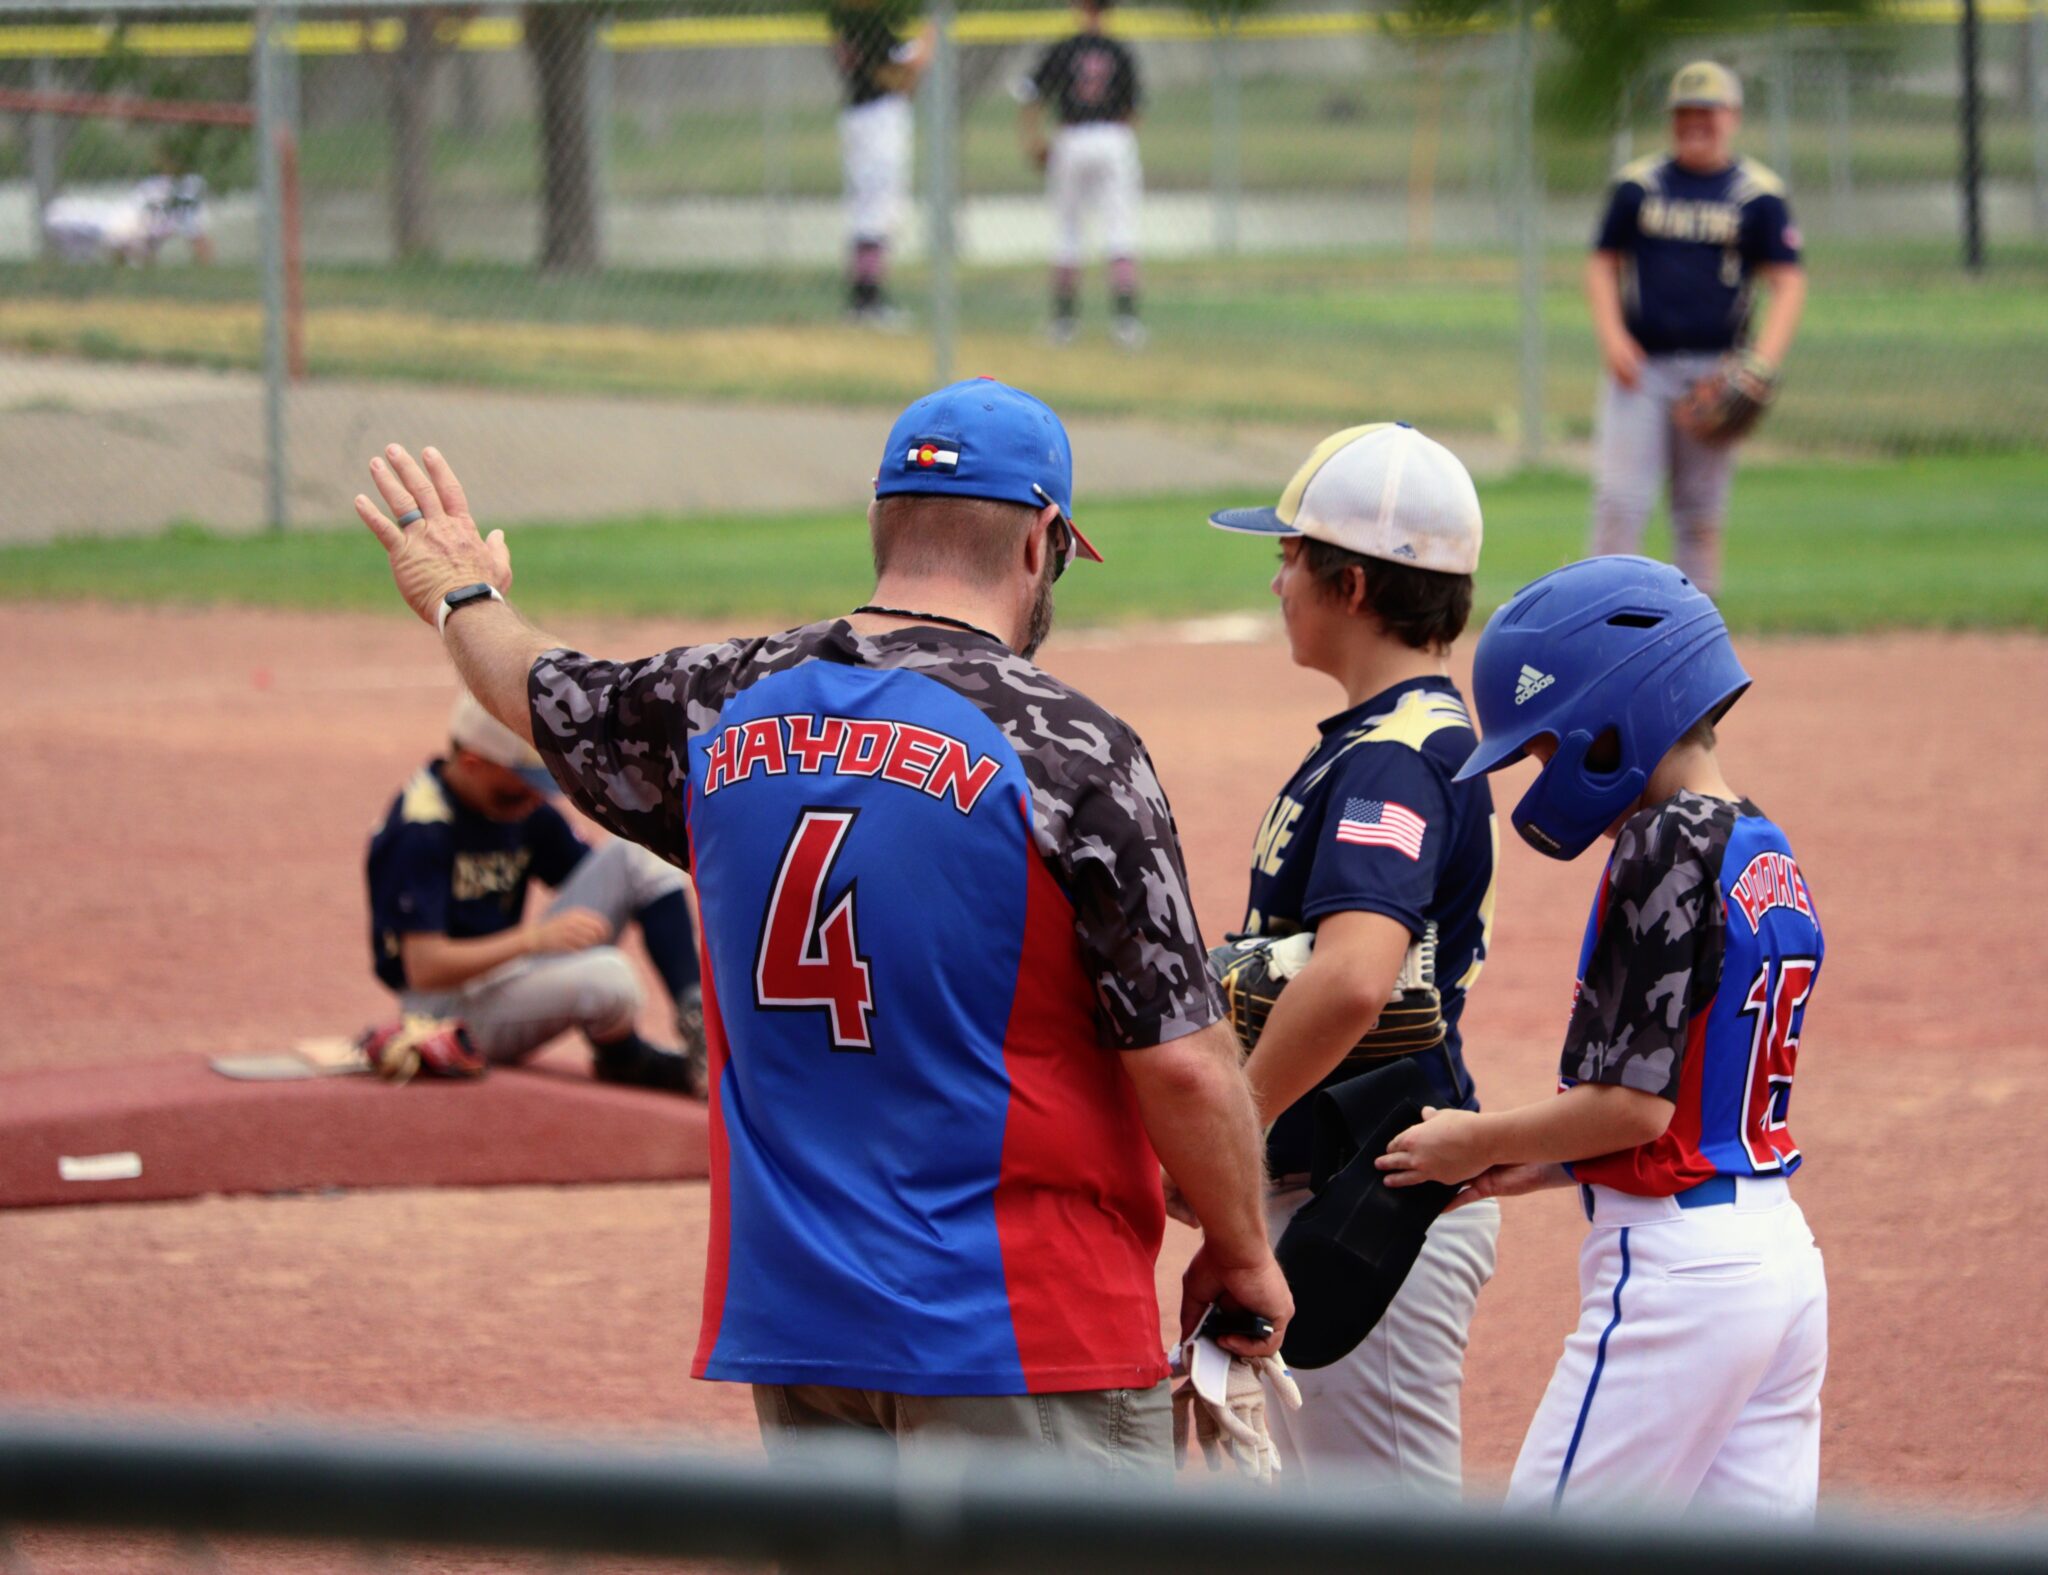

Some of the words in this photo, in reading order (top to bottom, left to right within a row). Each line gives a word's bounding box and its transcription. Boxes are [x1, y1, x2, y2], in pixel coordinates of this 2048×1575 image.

[1514, 673, 1556, 706] adidas
[704, 712, 1003, 816] HAYDEN
[753, 805, 877, 1055] 4
[1728, 849, 1819, 937] HOOKE
